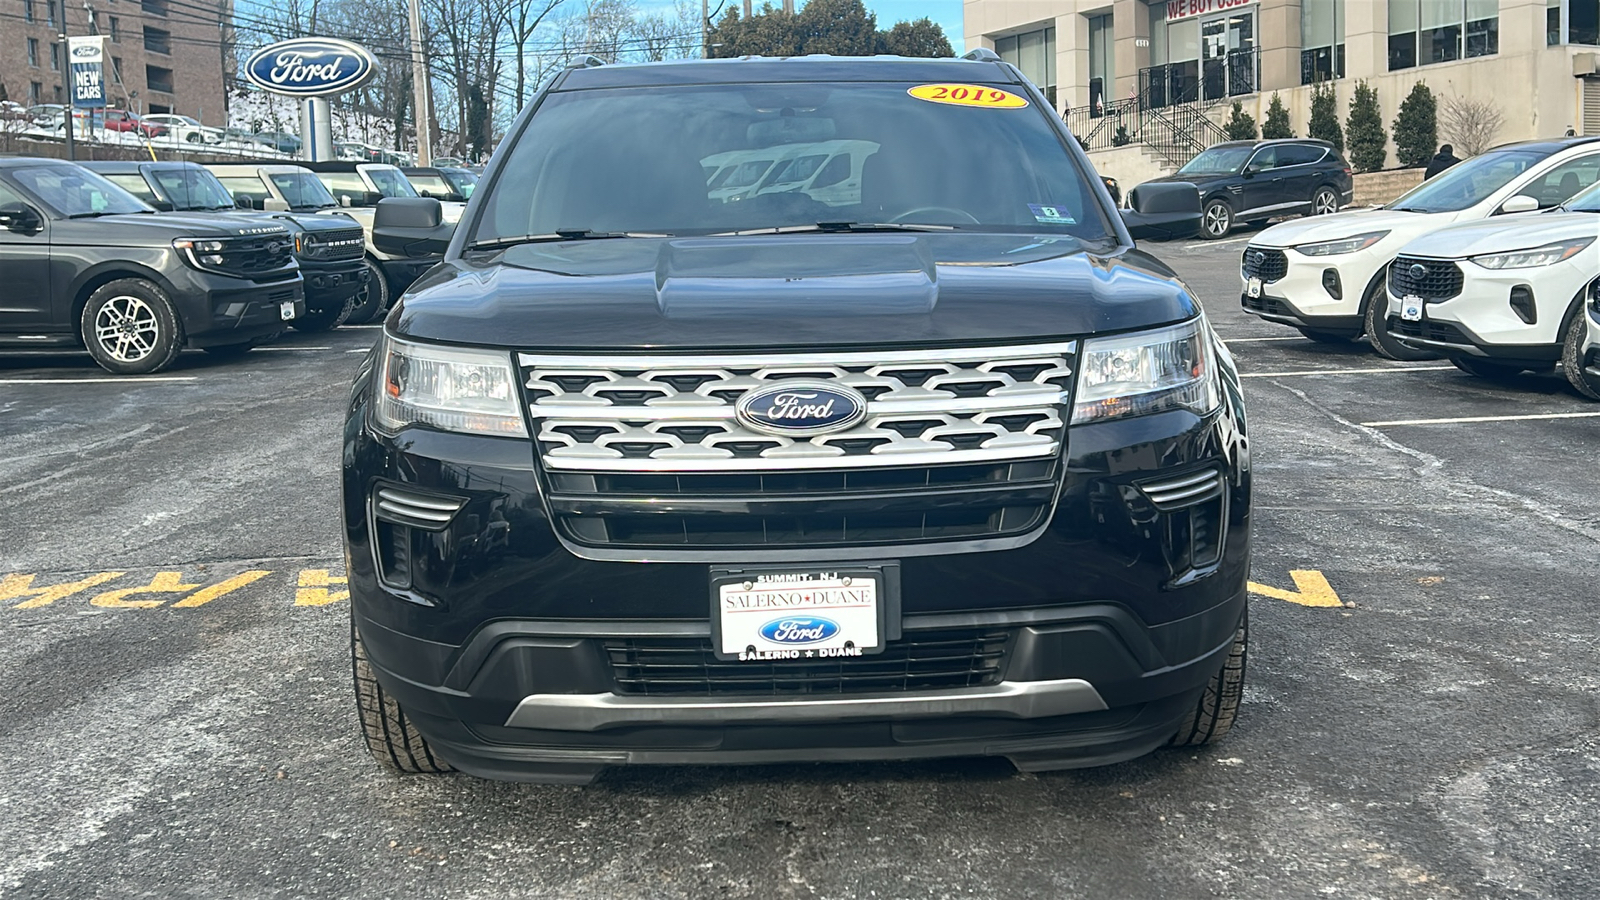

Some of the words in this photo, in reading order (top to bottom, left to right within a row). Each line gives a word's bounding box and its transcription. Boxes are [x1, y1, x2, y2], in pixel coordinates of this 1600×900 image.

[1168, 0, 1186, 19] WE
[1189, 0, 1213, 15] BUY
[270, 50, 343, 83] Ford
[76, 71, 99, 86] NEW
[77, 86, 101, 99] CARS
[931, 87, 1006, 103] 2019
[767, 392, 835, 420] Ford
[820, 572, 838, 580] NJ
[726, 592, 802, 609] SALERNO
[812, 590, 871, 605] DUANE
[774, 620, 824, 640] Ford
[738, 649, 800, 661] SALERNO
[819, 647, 862, 657] DUANE
